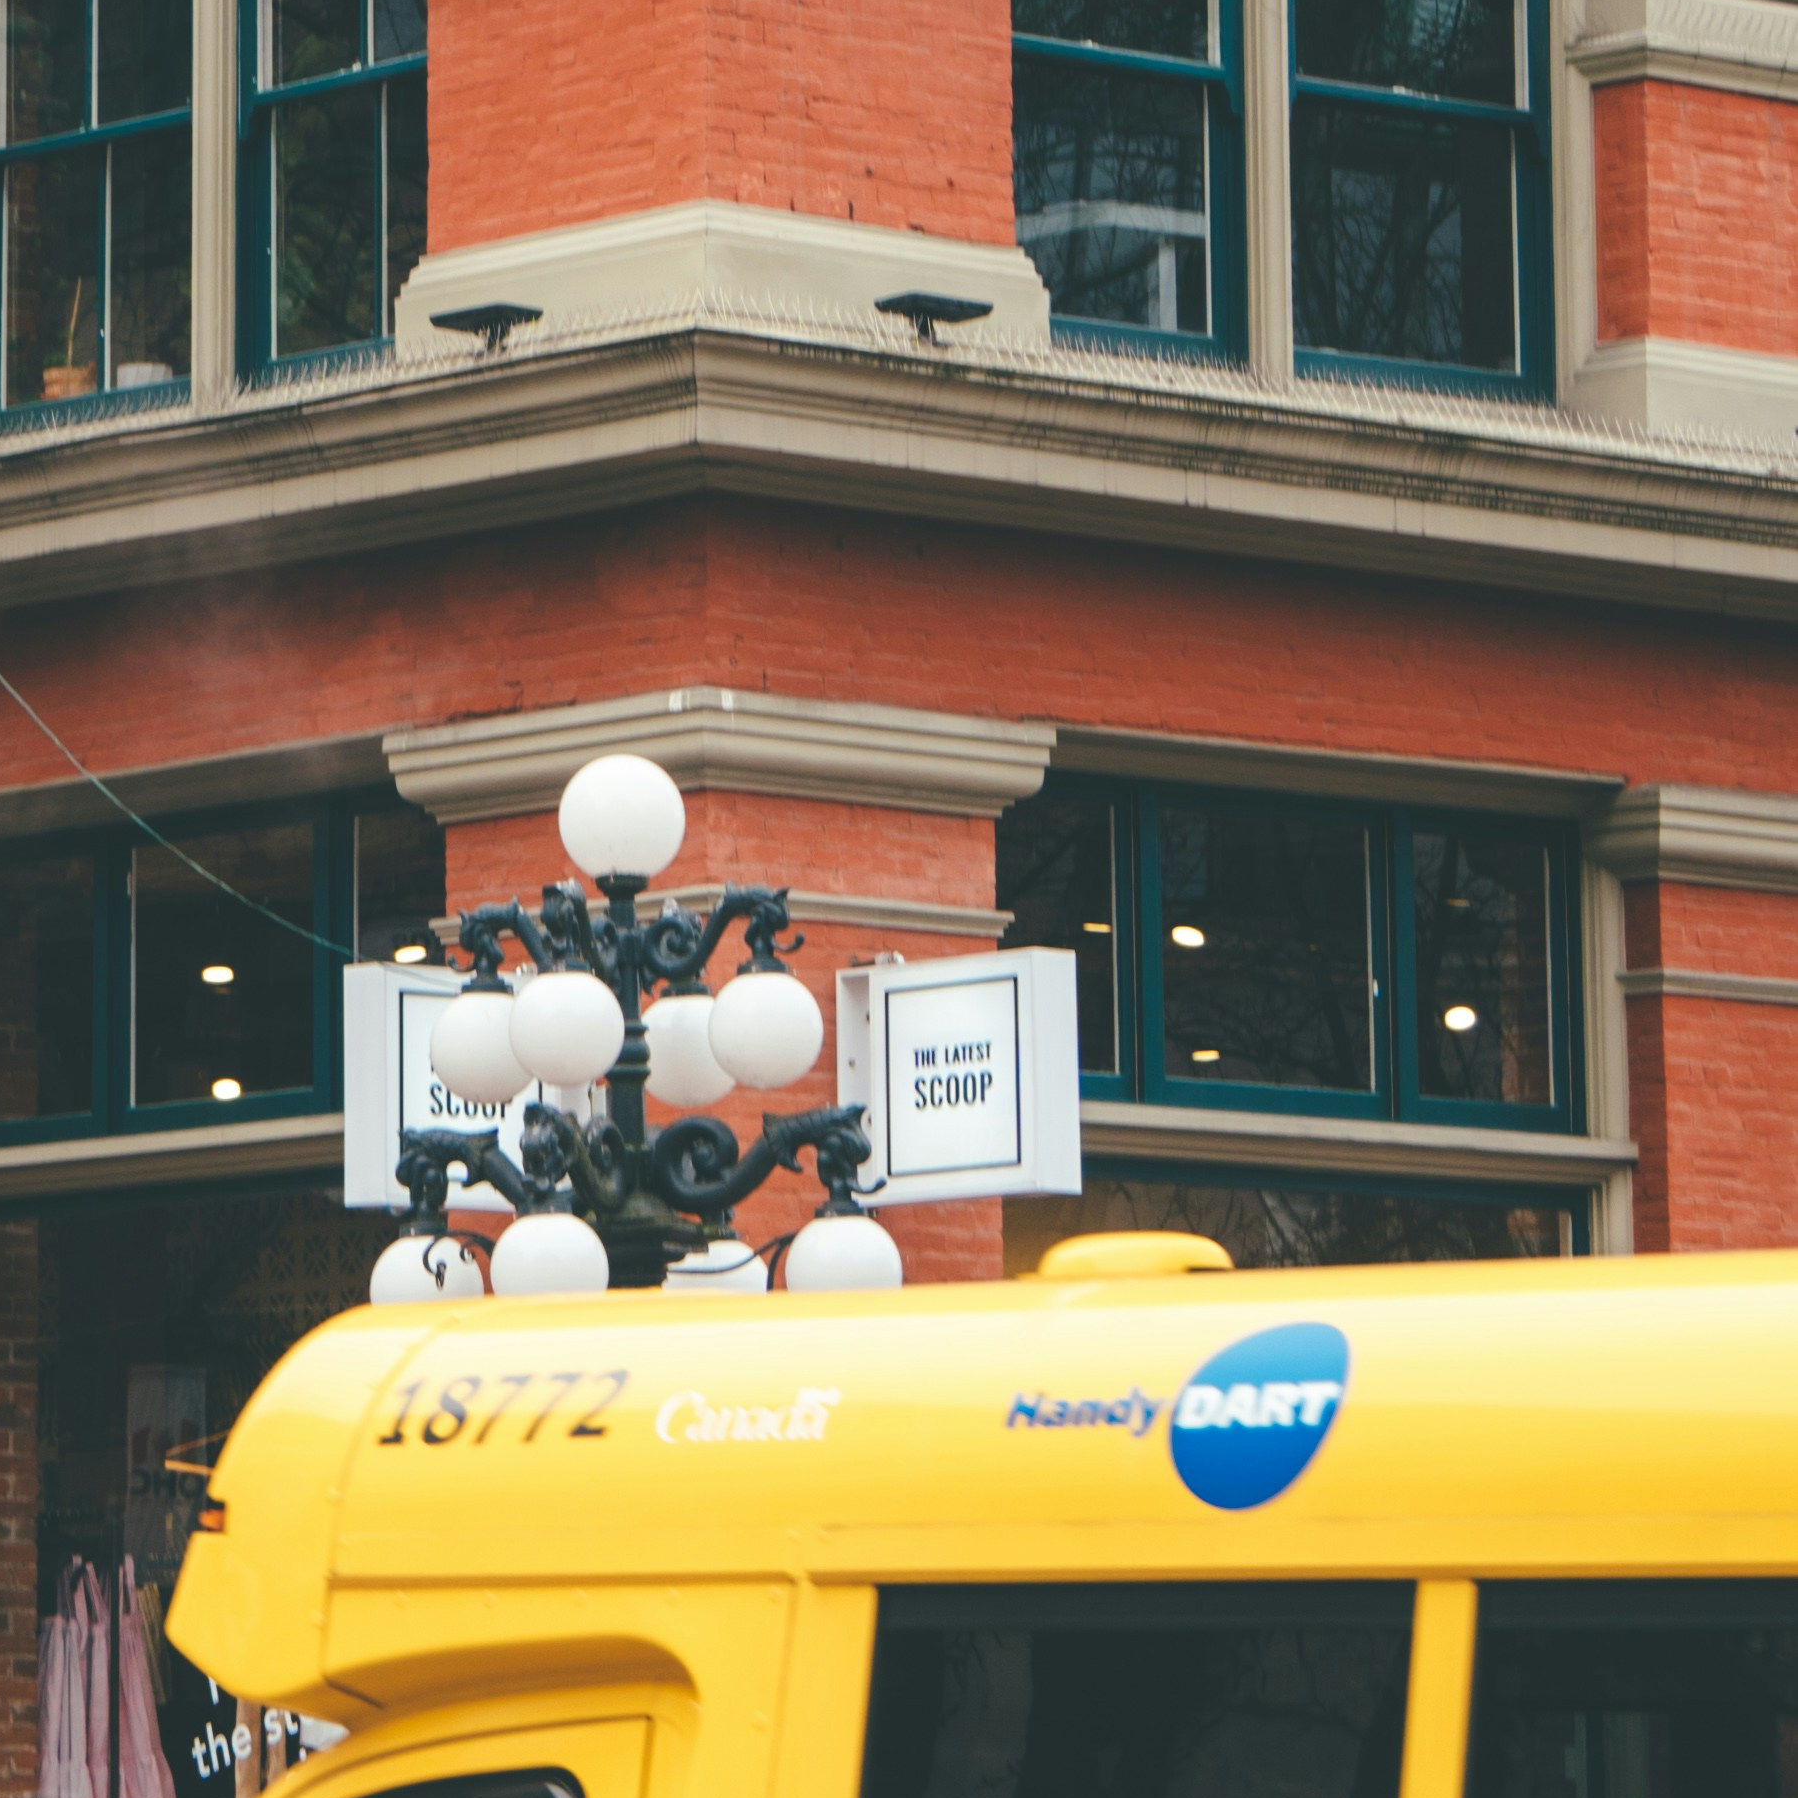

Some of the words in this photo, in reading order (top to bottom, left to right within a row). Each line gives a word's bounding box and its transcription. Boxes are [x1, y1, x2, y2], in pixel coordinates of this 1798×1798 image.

[913, 1046, 937, 1069] THE
[944, 1040, 991, 1064] LATEST
[914, 1070, 993, 1110] SCOOP
[378, 1368, 630, 1447] 18772
[1005, 1386, 1162, 1438] Handy
[1174, 1380, 1343, 1430] DART
[191, 1721, 252, 1779] the
